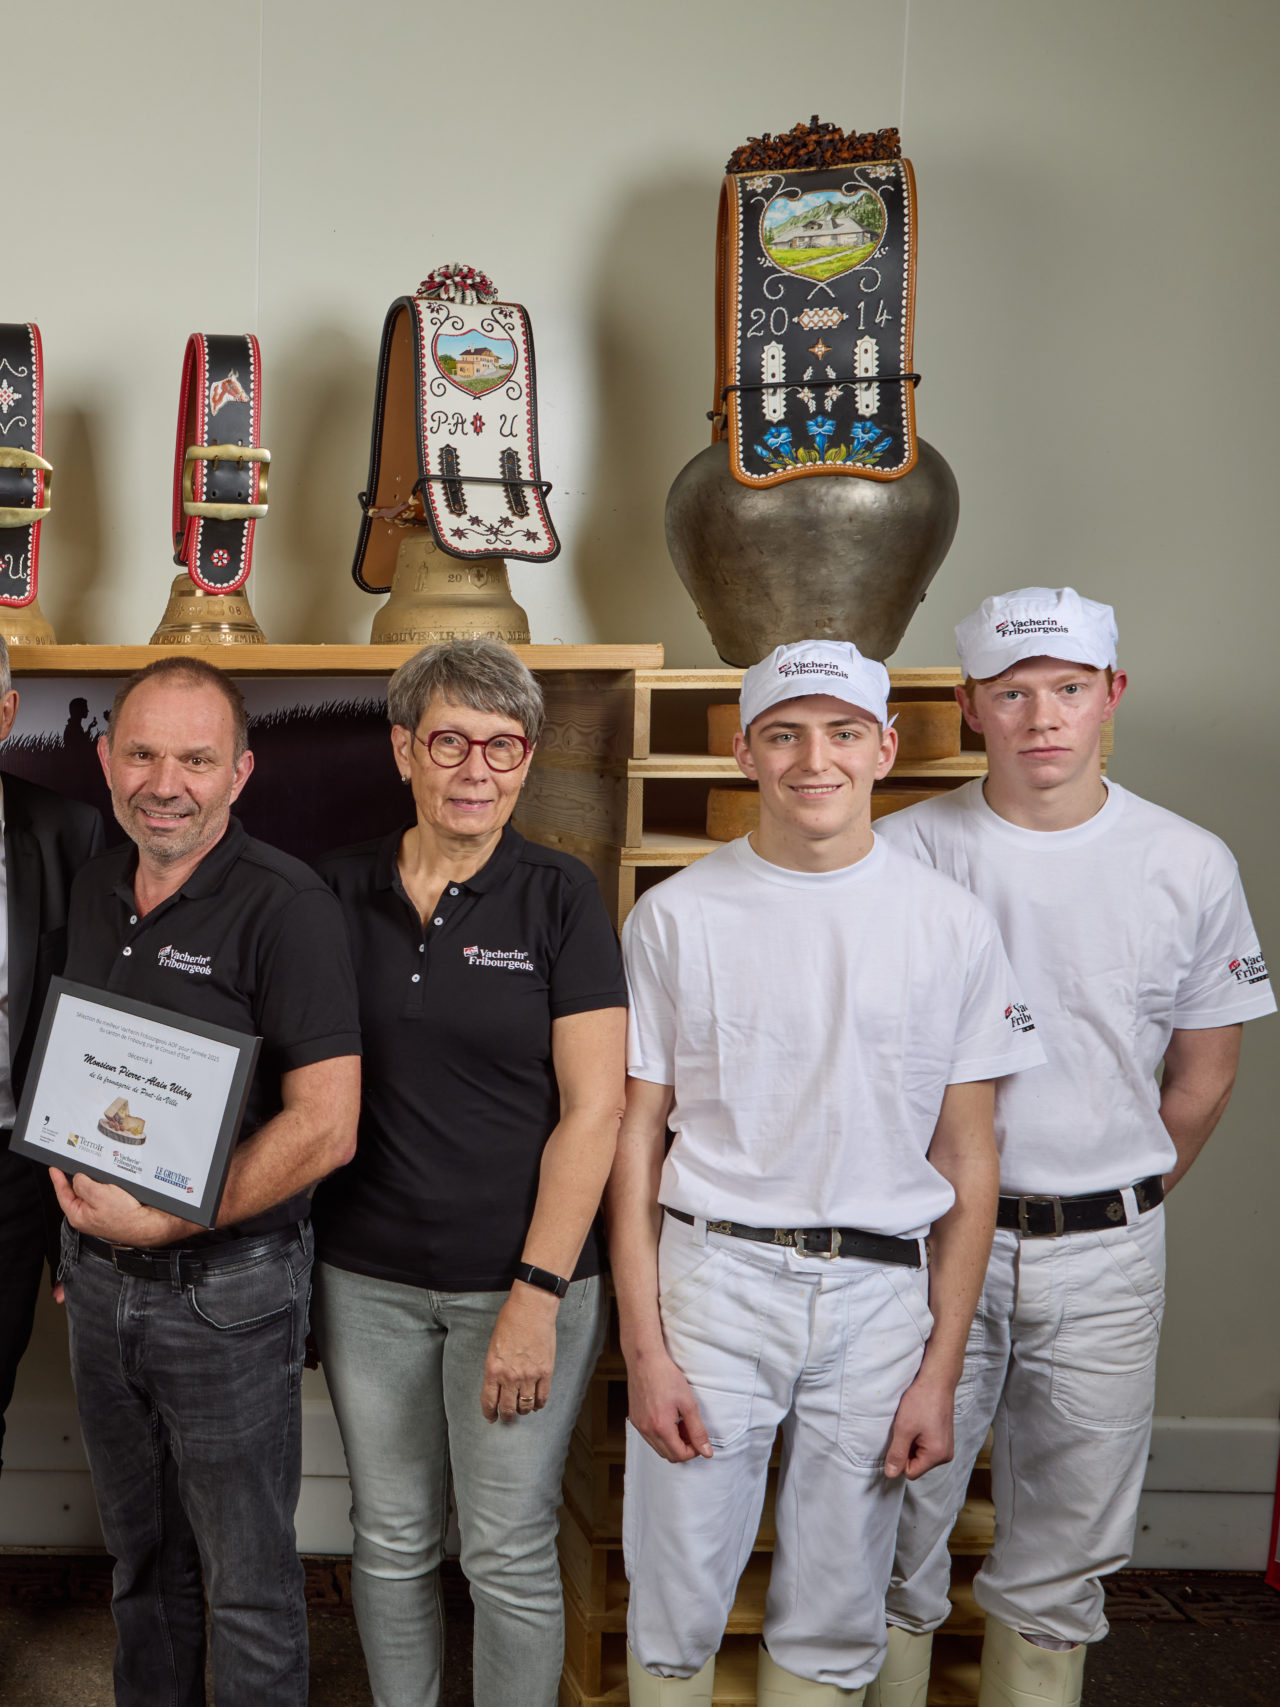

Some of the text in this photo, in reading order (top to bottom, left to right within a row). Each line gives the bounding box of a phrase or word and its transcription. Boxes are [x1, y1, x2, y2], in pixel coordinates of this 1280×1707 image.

[747, 300, 892, 338] 20 14
[448, 574, 462, 583] 20
[1010, 617, 1057, 628] Vacherin
[1001, 625, 1069, 637] Fribourgeois
[793, 660, 839, 670] Vacherin
[784, 668, 849, 679] Fribourgeois
[158, 956, 212, 975] Fribourgeois
[468, 956, 534, 971] Fribourgeois
[83, 1053, 193, 1100] Monsieur Pierre-Alain Uldry
[80, 1136, 104, 1152] Terroir
